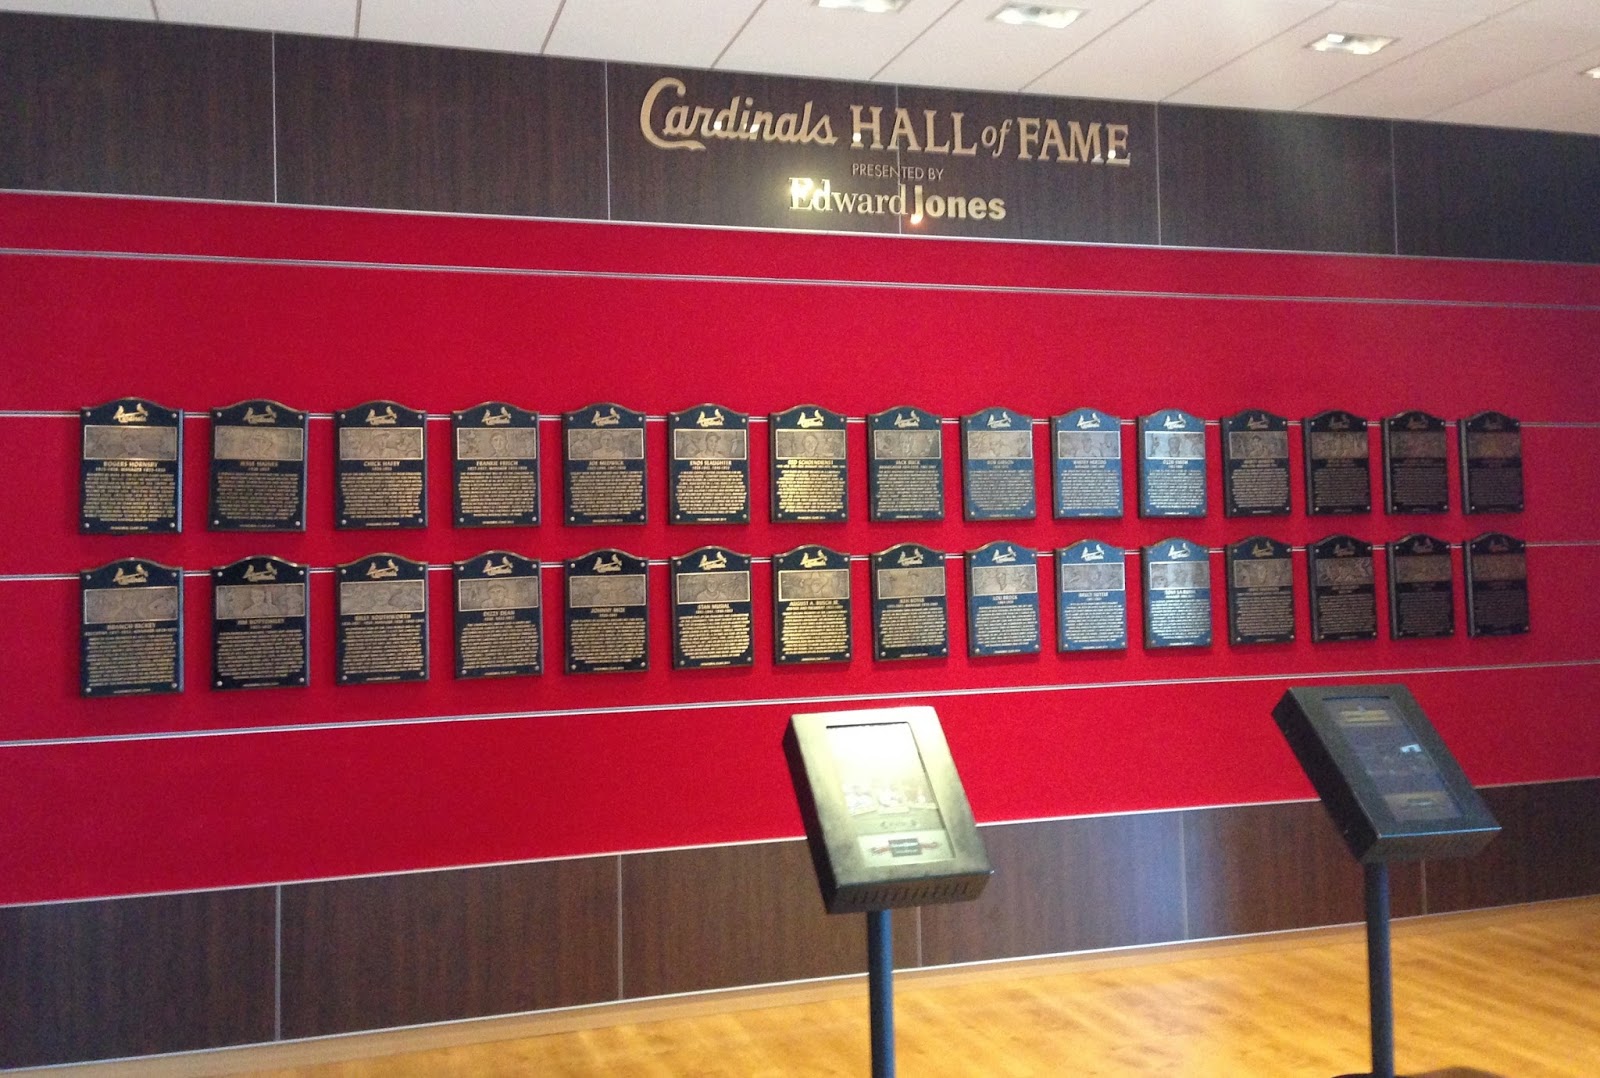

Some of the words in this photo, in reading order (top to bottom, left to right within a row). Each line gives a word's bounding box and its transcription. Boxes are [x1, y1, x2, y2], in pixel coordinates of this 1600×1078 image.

[639, 77, 838, 151] Cardinals
[850, 104, 977, 155] HALL
[981, 119, 1013, 157] of
[1017, 117, 1132, 166] FAME
[851, 163, 924, 181] PRESENTED
[927, 167, 945, 181] BY
